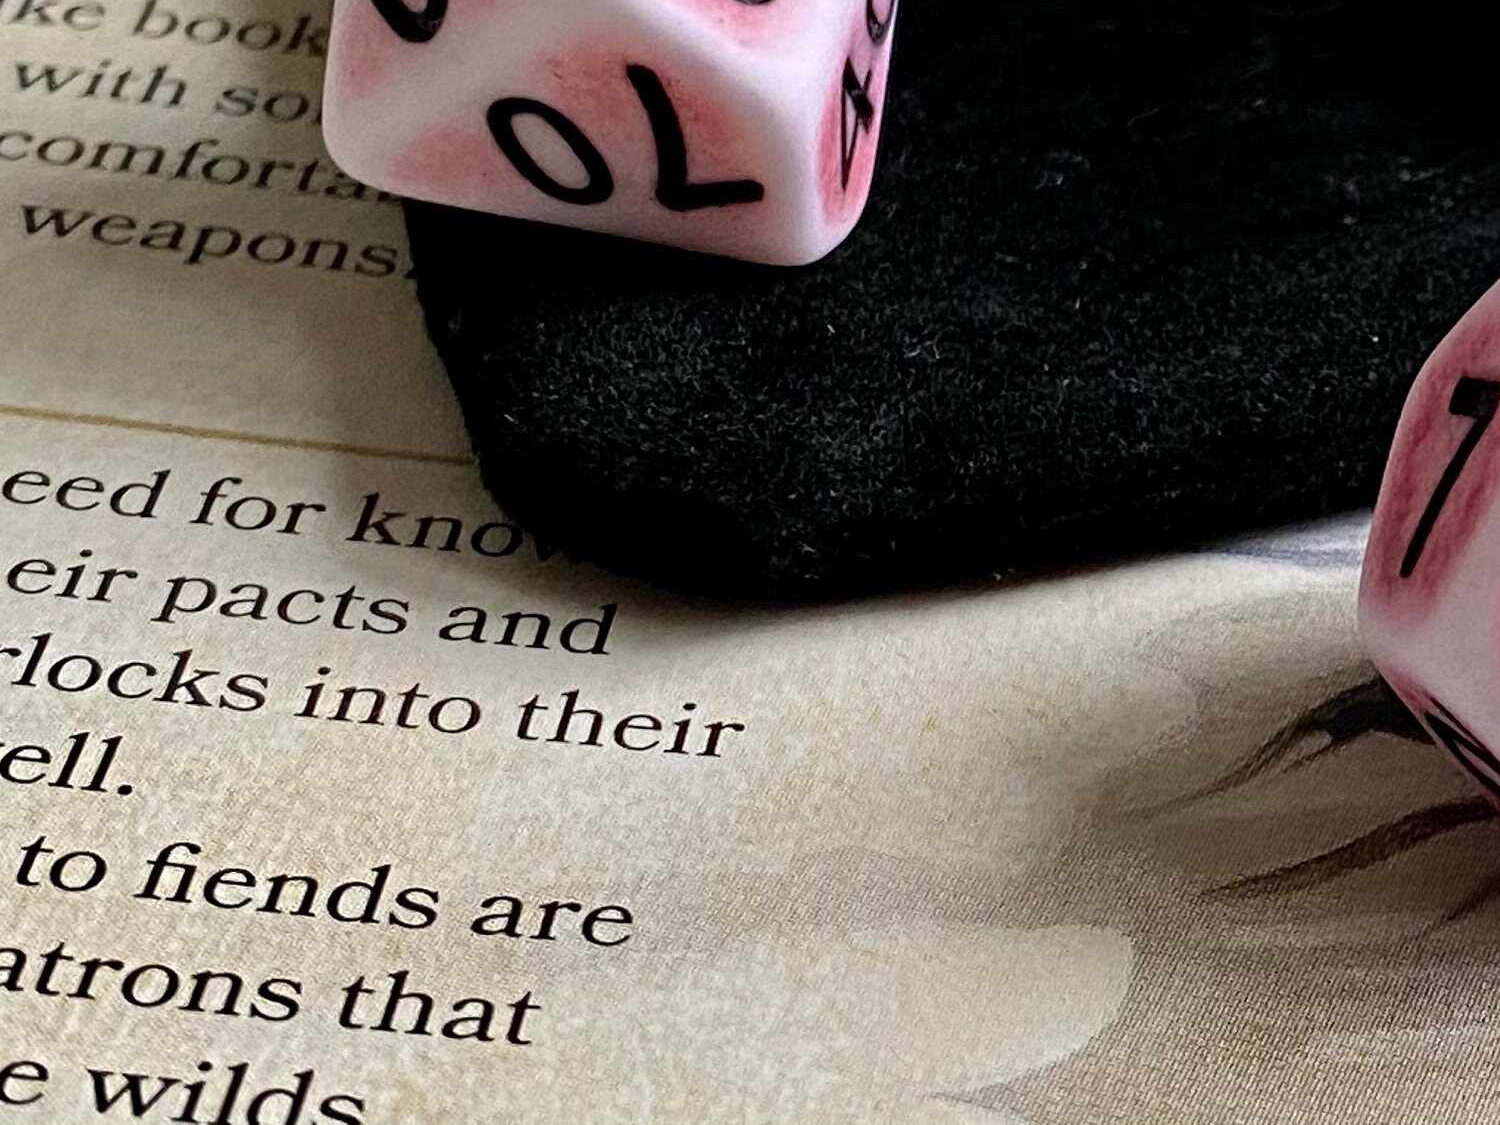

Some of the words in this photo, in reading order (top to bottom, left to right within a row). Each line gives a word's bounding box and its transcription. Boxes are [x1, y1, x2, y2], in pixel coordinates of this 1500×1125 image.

[15, 59, 188, 108] with
[214, 85, 322, 127] so
[2, 470, 171, 518] eed
[189, 476, 326, 533] for
[6, 549, 138, 603] eir
[150, 574, 410, 635] pacts
[438, 603, 618, 656] and
[293, 666, 482, 735] into
[516, 689, 746, 758] their
[0, 732, 133, 795] ell.
[16, 835, 108, 893] to
[134, 841, 440, 930] fiends
[469, 895, 634, 947] are
[337, 970, 541, 1045] that
[86, 1061, 366, 1125] wilds
